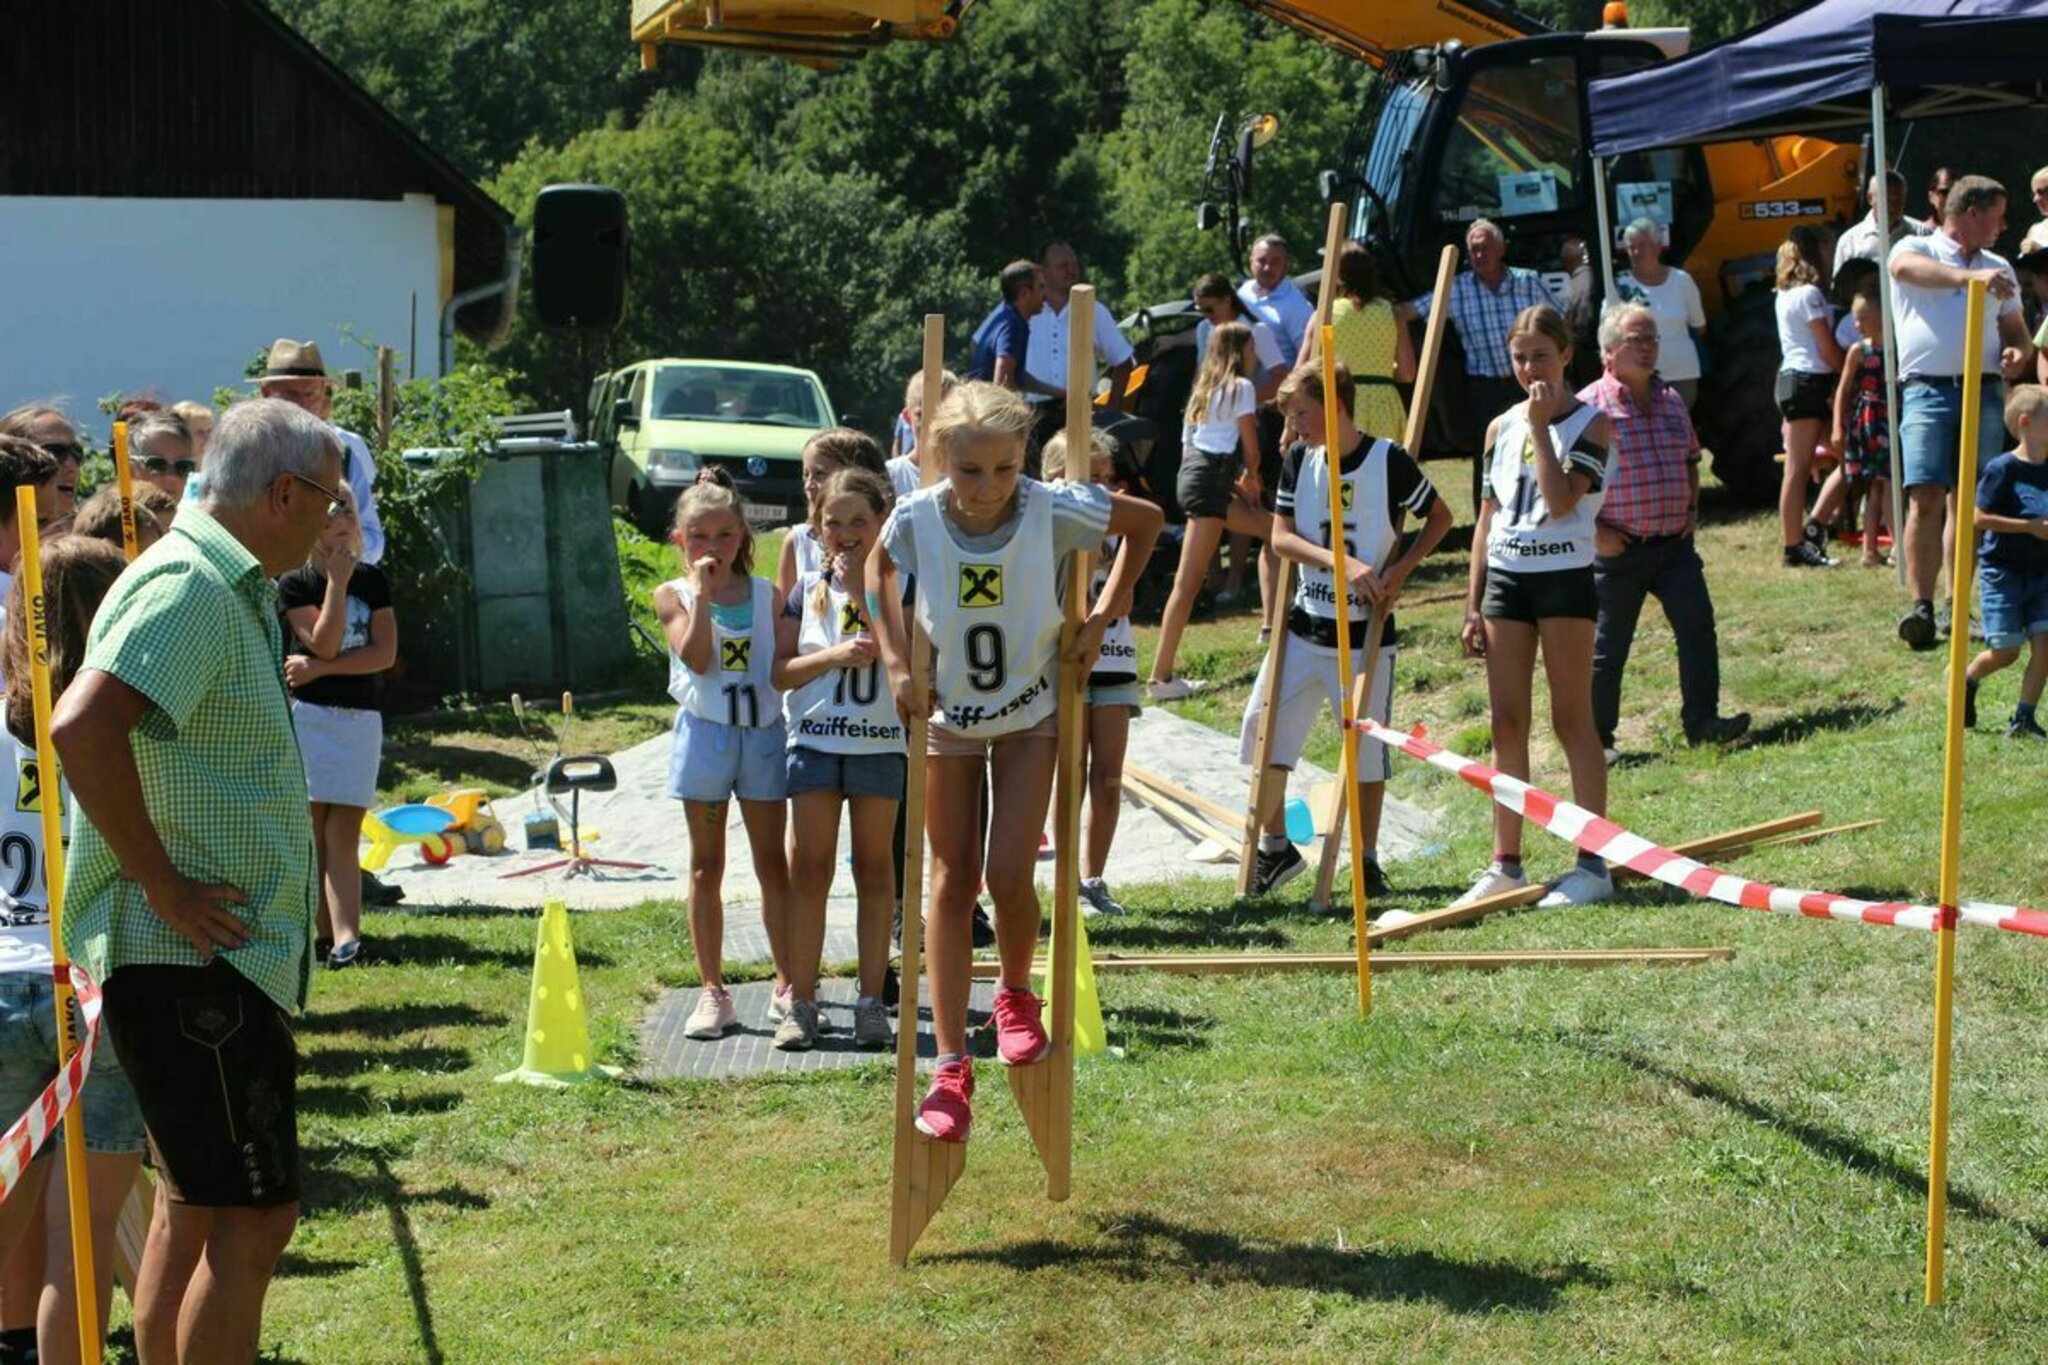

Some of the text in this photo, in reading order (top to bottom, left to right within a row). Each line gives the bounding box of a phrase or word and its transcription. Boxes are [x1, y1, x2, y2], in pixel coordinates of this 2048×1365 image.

[32, 595, 47, 638] JAKO
[964, 622, 1007, 693] 9
[721, 682, 760, 728] 11
[799, 718, 900, 740] Raiffeisen
